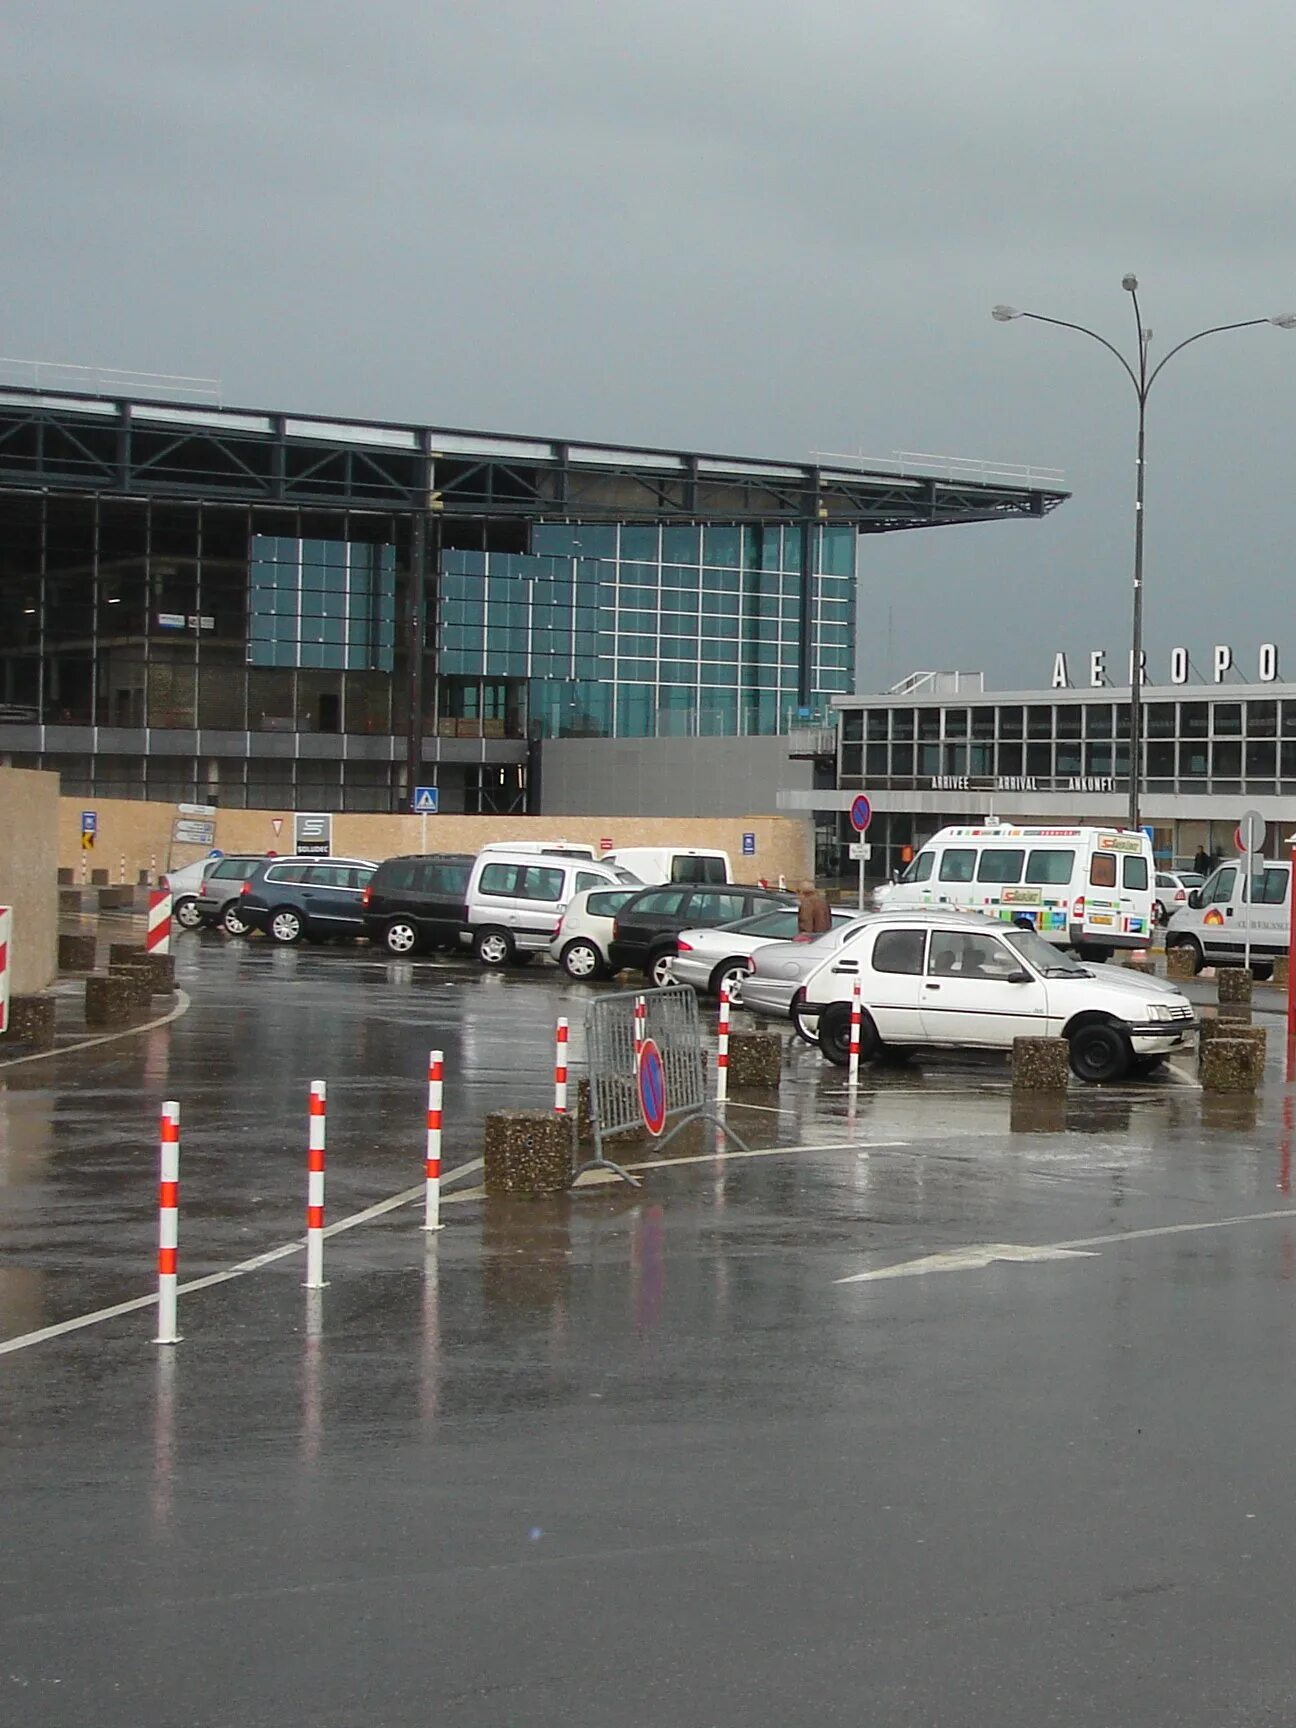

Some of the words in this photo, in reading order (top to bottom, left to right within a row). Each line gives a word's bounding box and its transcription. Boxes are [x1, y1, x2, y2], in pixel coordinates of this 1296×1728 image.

[932, 776, 969, 790] ARRIVEE
[998, 776, 1038, 791] ARRIVAL
[1068, 777, 1111, 791] ANKUNFT
[297, 845, 329, 853] SOLUDEC
